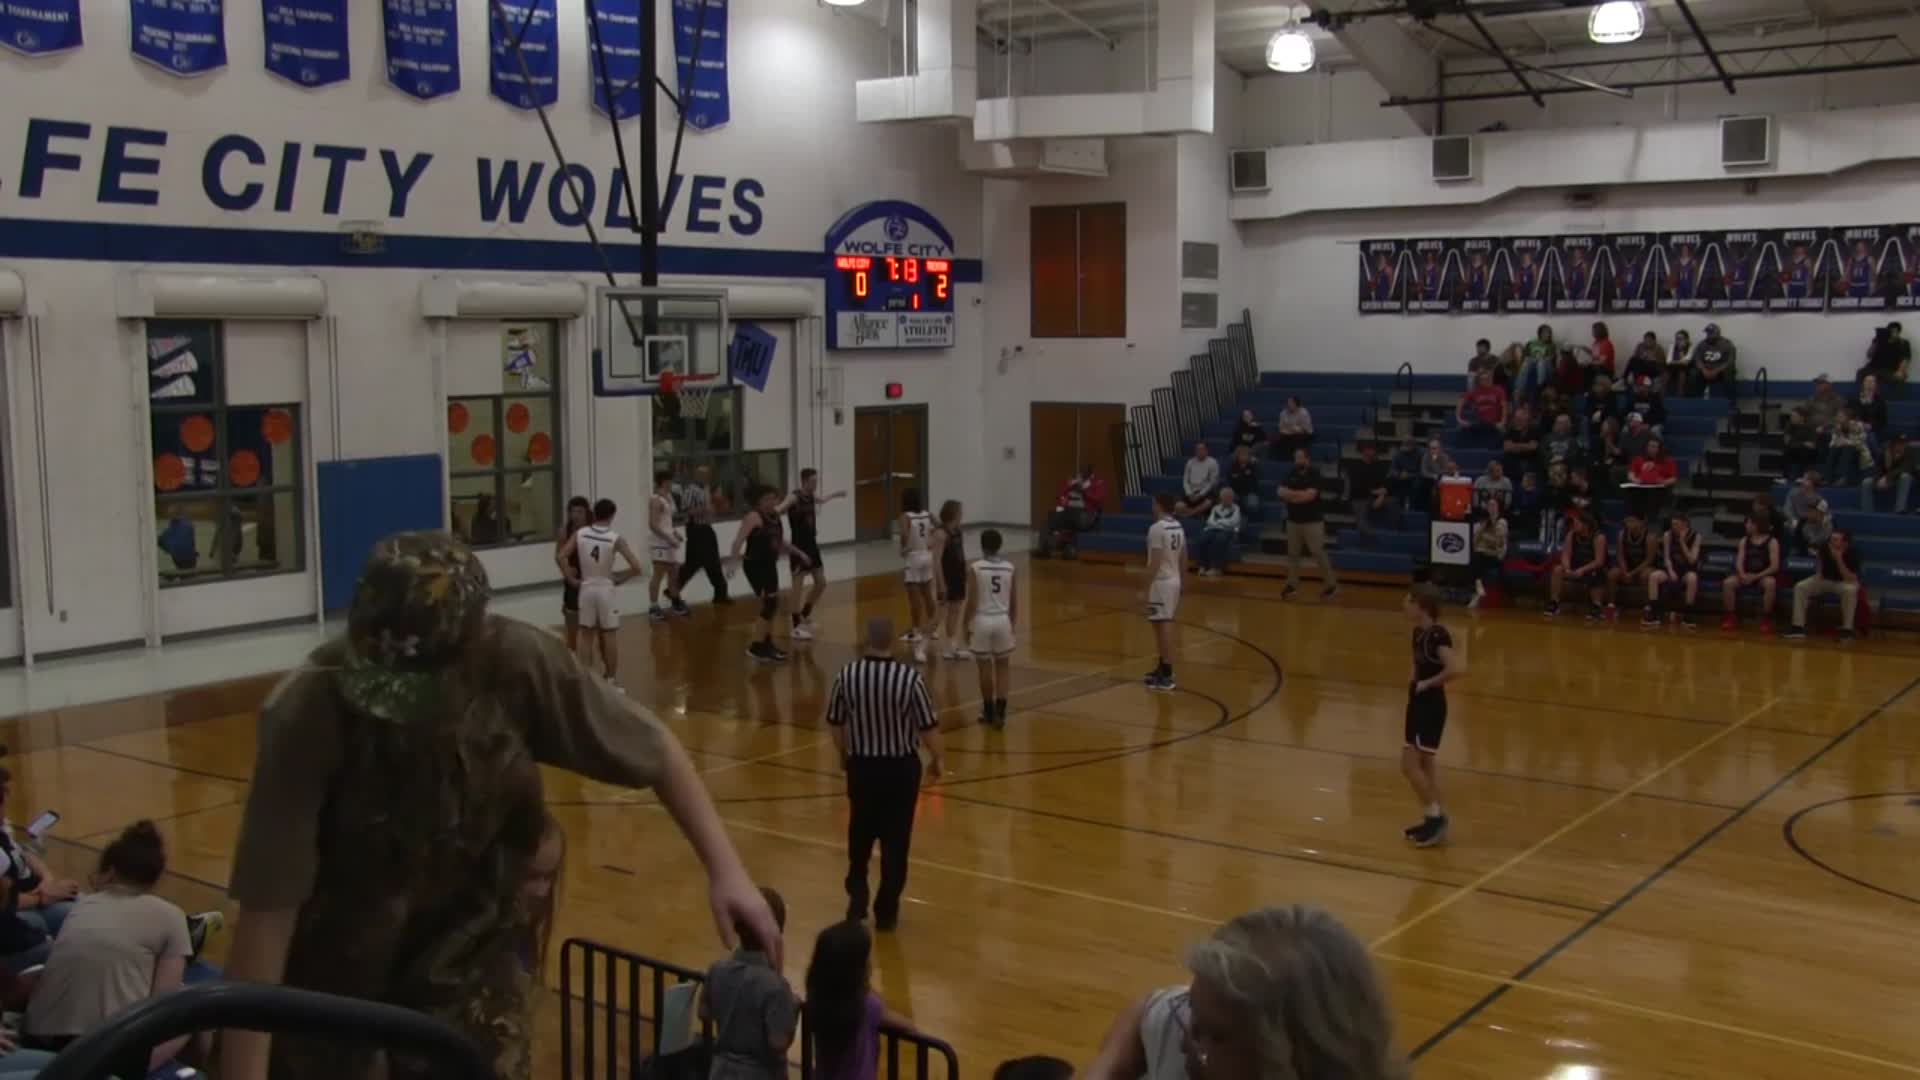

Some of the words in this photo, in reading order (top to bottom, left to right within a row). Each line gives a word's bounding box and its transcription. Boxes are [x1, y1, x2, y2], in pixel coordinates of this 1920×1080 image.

[201, 134, 434, 218] CITY
[477, 156, 766, 236] WOLVES
[844, 241, 903, 255] WOLFE
[907, 244, 945, 257] CITY
[886, 256, 918, 283] 7:13
[855, 271, 867, 297] 0
[937, 274, 948, 298] 2
[590, 545, 600, 563] 4
[991, 575, 1001, 594] 5
